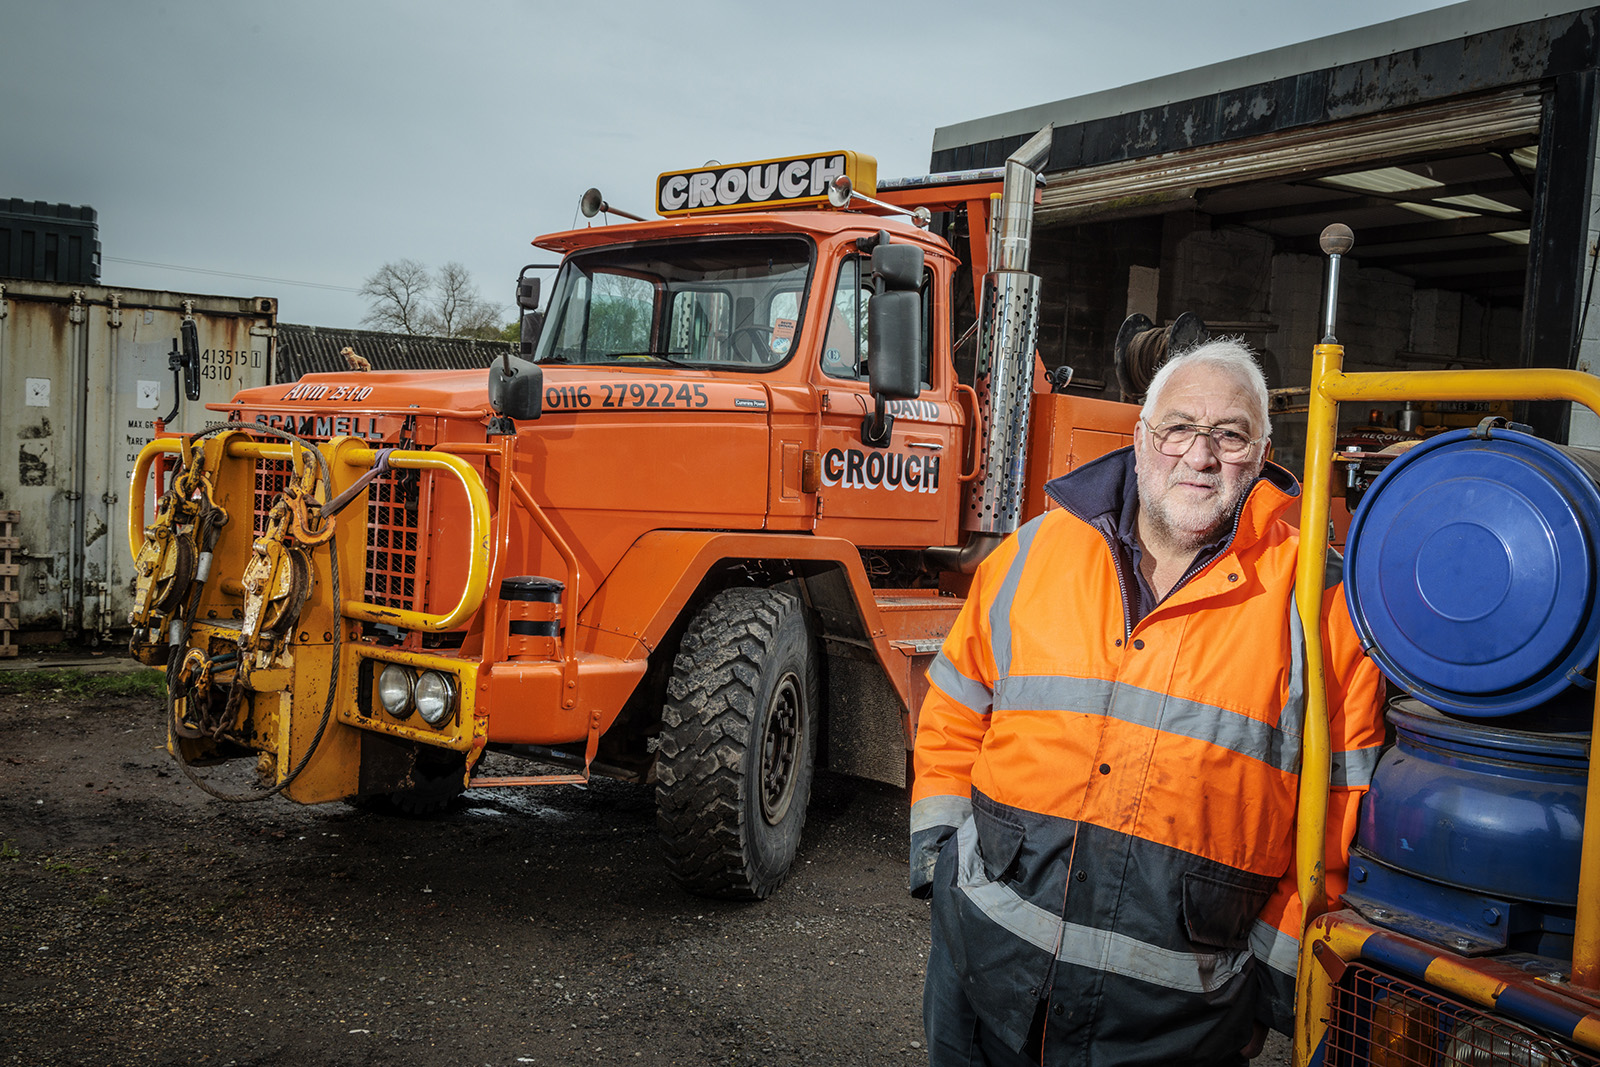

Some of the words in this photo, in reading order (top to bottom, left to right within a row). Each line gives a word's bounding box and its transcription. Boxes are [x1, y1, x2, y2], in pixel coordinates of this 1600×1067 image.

[661, 155, 845, 211] CROUCH
[202, 349, 247, 365] 413515
[201, 365, 232, 380] 4310
[280, 383, 329, 401] Alvin
[546, 386, 592, 408] 0116
[600, 383, 709, 408] 2792245
[886, 400, 940, 422] DAVID
[255, 414, 384, 439] SCAMMELL
[128, 437, 143, 445] TARE
[820, 448, 940, 494] CROUCH
